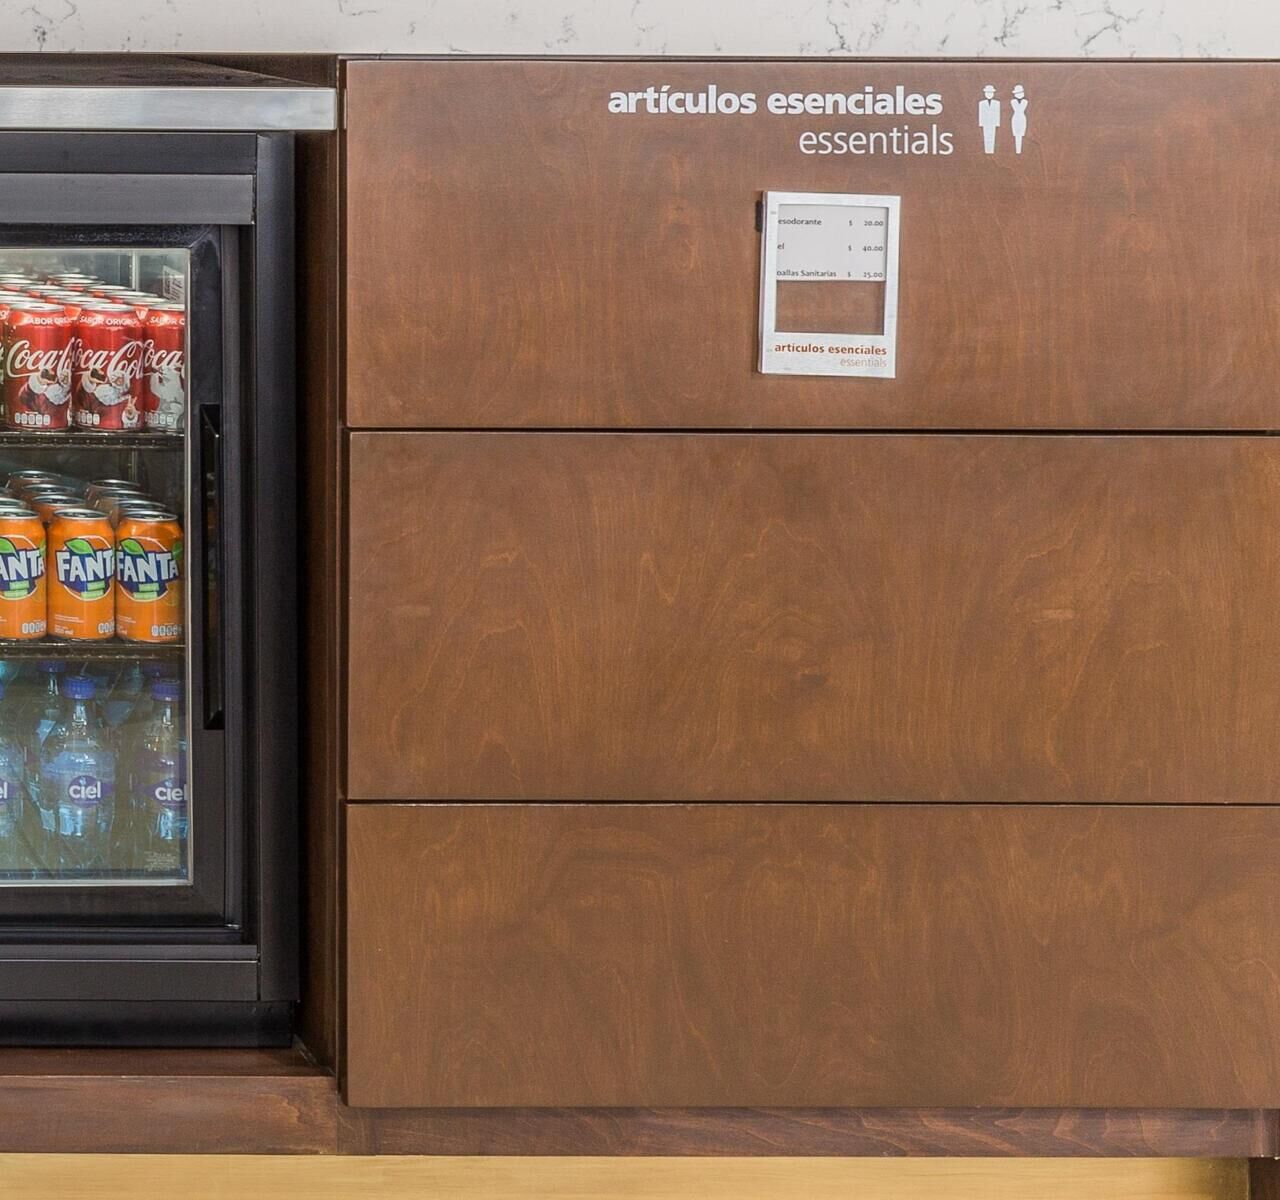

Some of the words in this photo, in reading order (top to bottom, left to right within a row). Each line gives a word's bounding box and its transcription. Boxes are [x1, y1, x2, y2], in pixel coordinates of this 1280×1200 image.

[608, 85, 757, 115] artículos
[767, 86, 942, 115] esenciales
[799, 124, 954, 155] essentials
[828, 345, 887, 355] esenciales
[840, 358, 887, 367] essentials
[117, 550, 179, 583] FANTA
[68, 780, 101, 799] ciel
